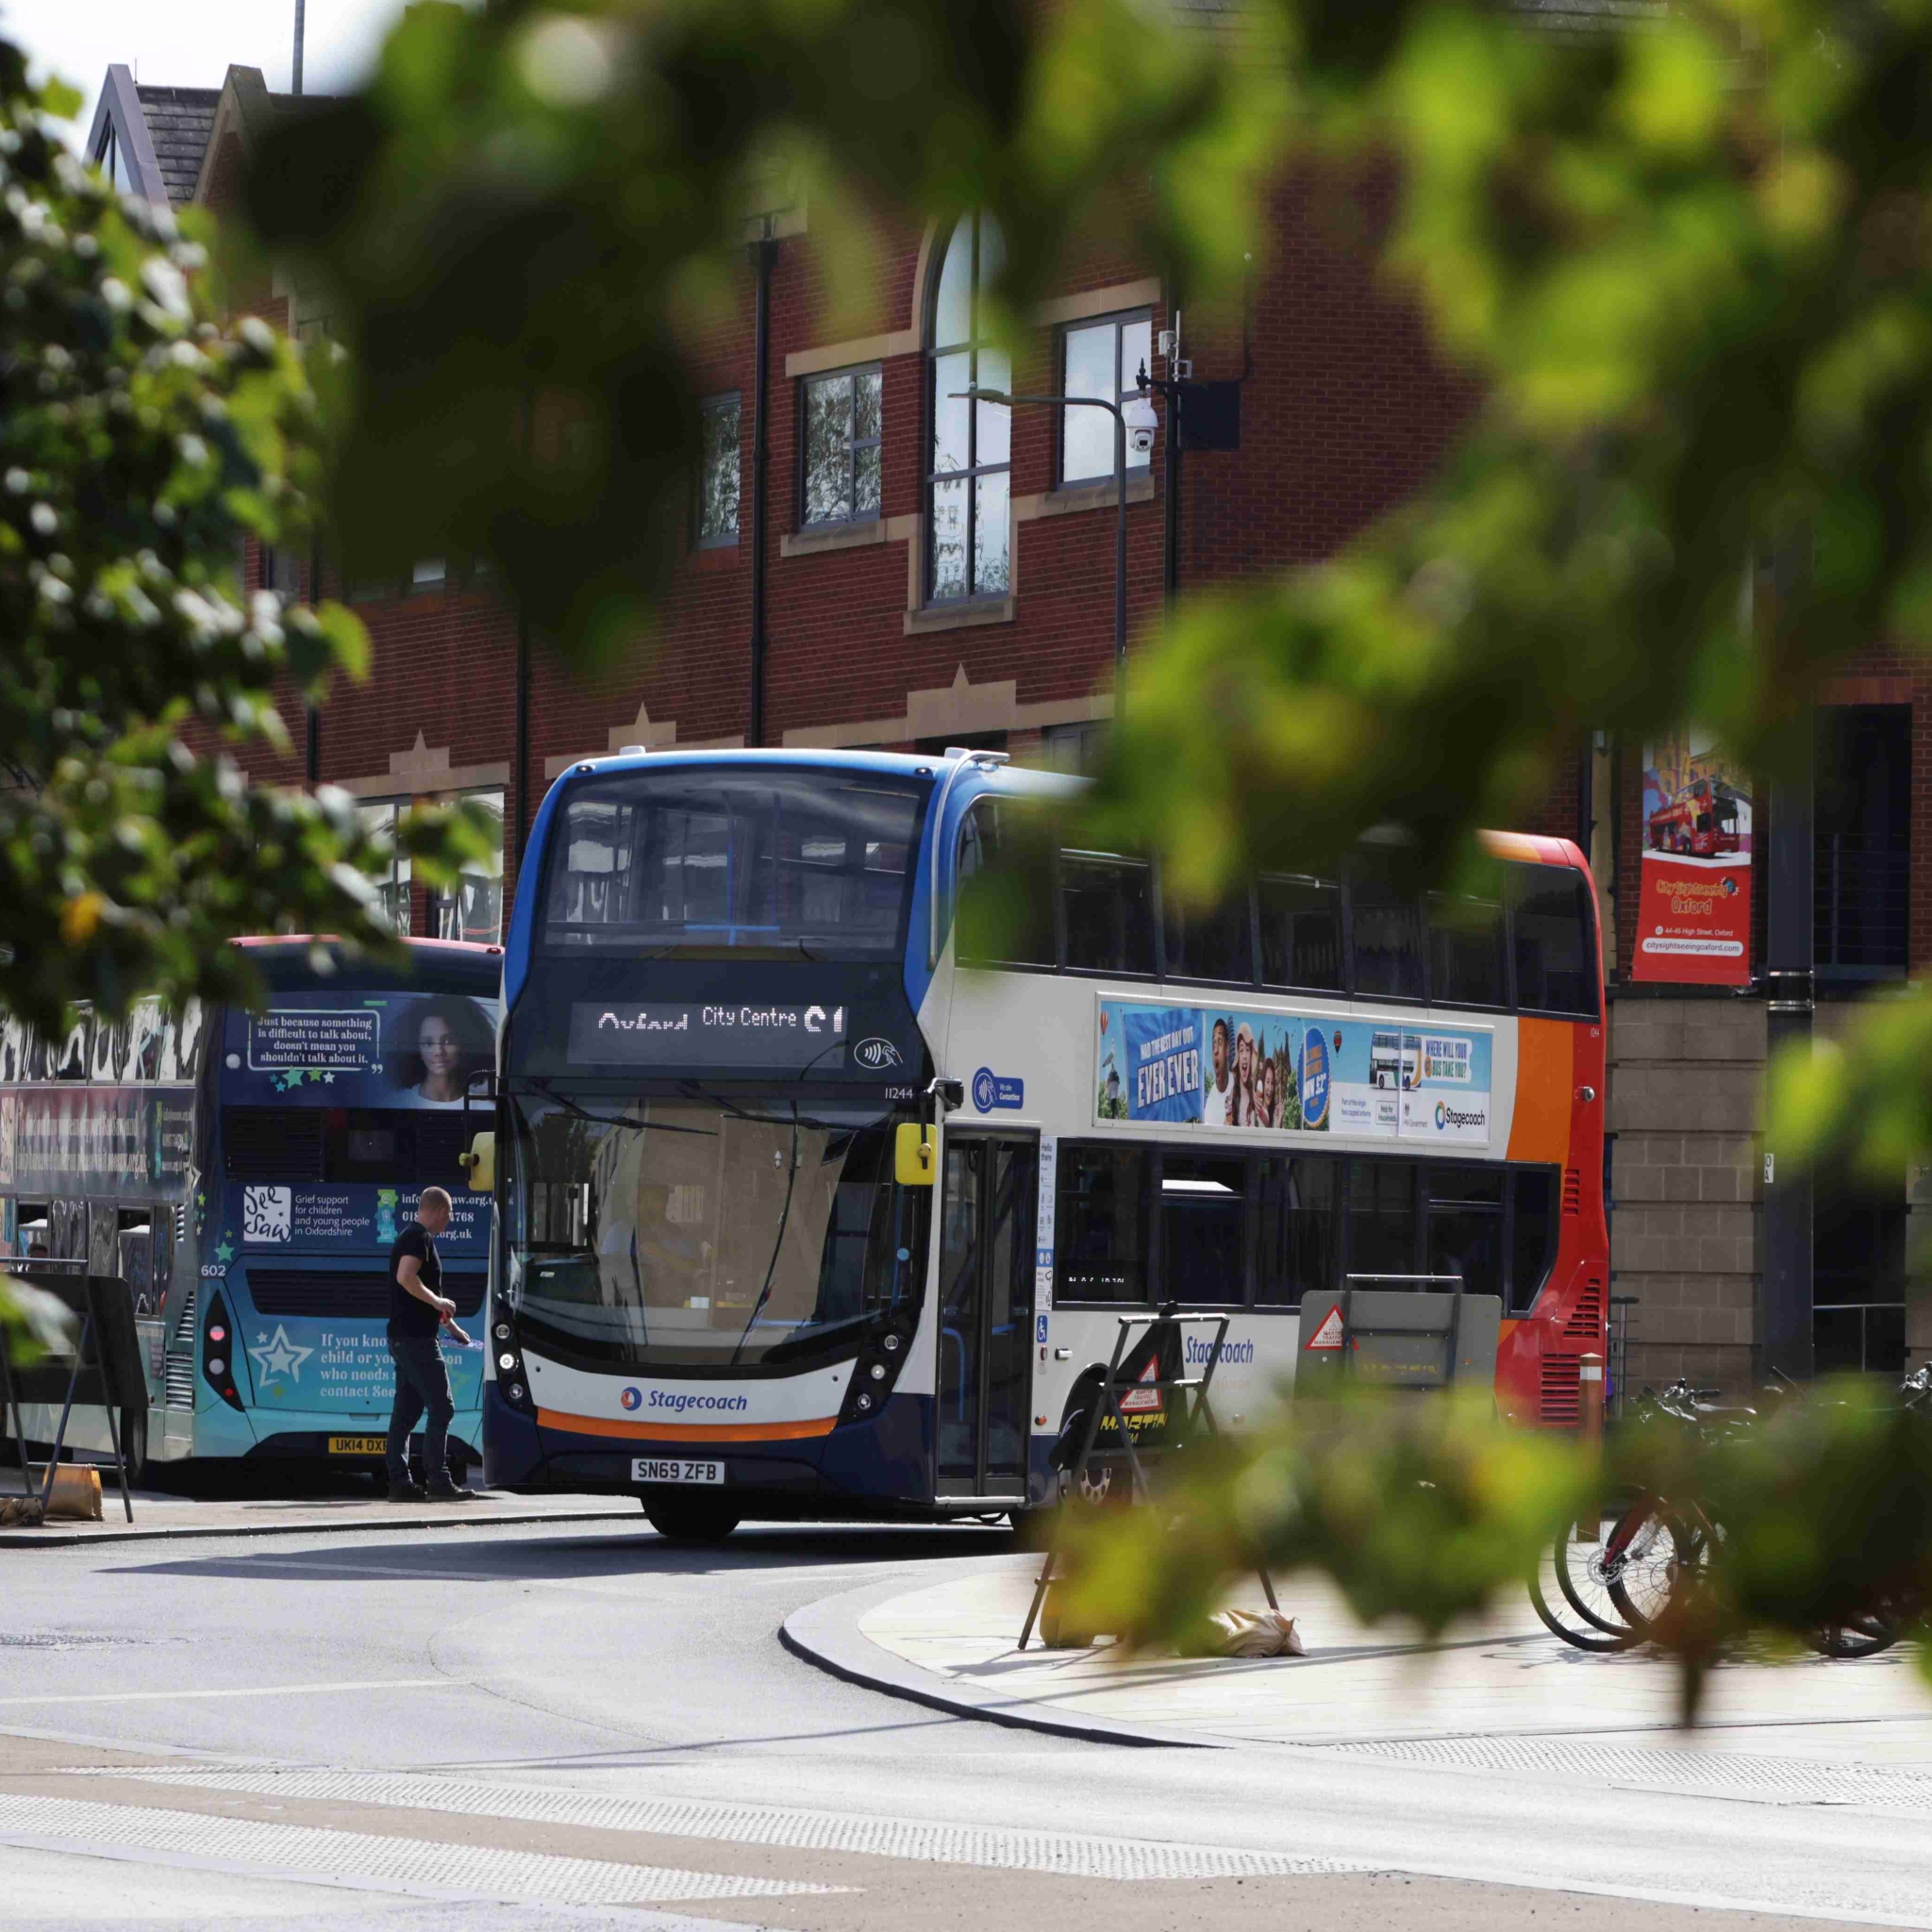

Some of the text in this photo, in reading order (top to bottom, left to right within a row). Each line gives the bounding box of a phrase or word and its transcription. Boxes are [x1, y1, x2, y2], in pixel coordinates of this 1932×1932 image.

[1672, 896, 1712, 914] Oxford
[1682, 928, 1695, 937] High
[1646, 941, 1740, 953] citysightseeingoxford.com
[258, 1016, 372, 1030] Just because something
[703, 1007, 797, 1026] City Centre
[258, 1028, 372, 1041] is difficult to talk about,
[274, 1041, 308, 1050] doesn't
[339, 1043, 356, 1053] you
[1426, 1040, 1467, 1059] WHERE WILL YOUR
[260, 1052, 369, 1063] shouldn't talk about it.
[1442, 1060, 1454, 1077] TAKE
[1455, 1061, 1467, 1078] YOU?
[1138, 1048, 1198, 1108] EVER EVER
[885, 1088, 914, 1100] 11244
[1446, 1108, 1486, 1128] Stagecoach
[1041, 1142, 1052, 1152] Hello
[1041, 1152, 1052, 1161] there
[245, 1186, 283, 1215] See
[295, 1194, 349, 1207] Grief support
[295, 1206, 342, 1215] for children
[245, 1214, 291, 1242] Saw
[295, 1216, 371, 1227] and young people
[305, 1226, 353, 1237] Oxfordshire
[201, 1265, 226, 1276] 602
[321, 1334, 388, 1350] If you kno
[1185, 1335, 1254, 1364] Stagcoach
[321, 1351, 354, 1364] child
[357, 1353, 373, 1364] or
[320, 1368, 348, 1381] who
[351, 1369, 390, 1381] needs
[320, 1385, 396, 1398] contact See
[648, 1391, 747, 1412] Stagecoach
[336, 1439, 363, 1452] UK14
[638, 1461, 717, 1480] SN69 ZFB
